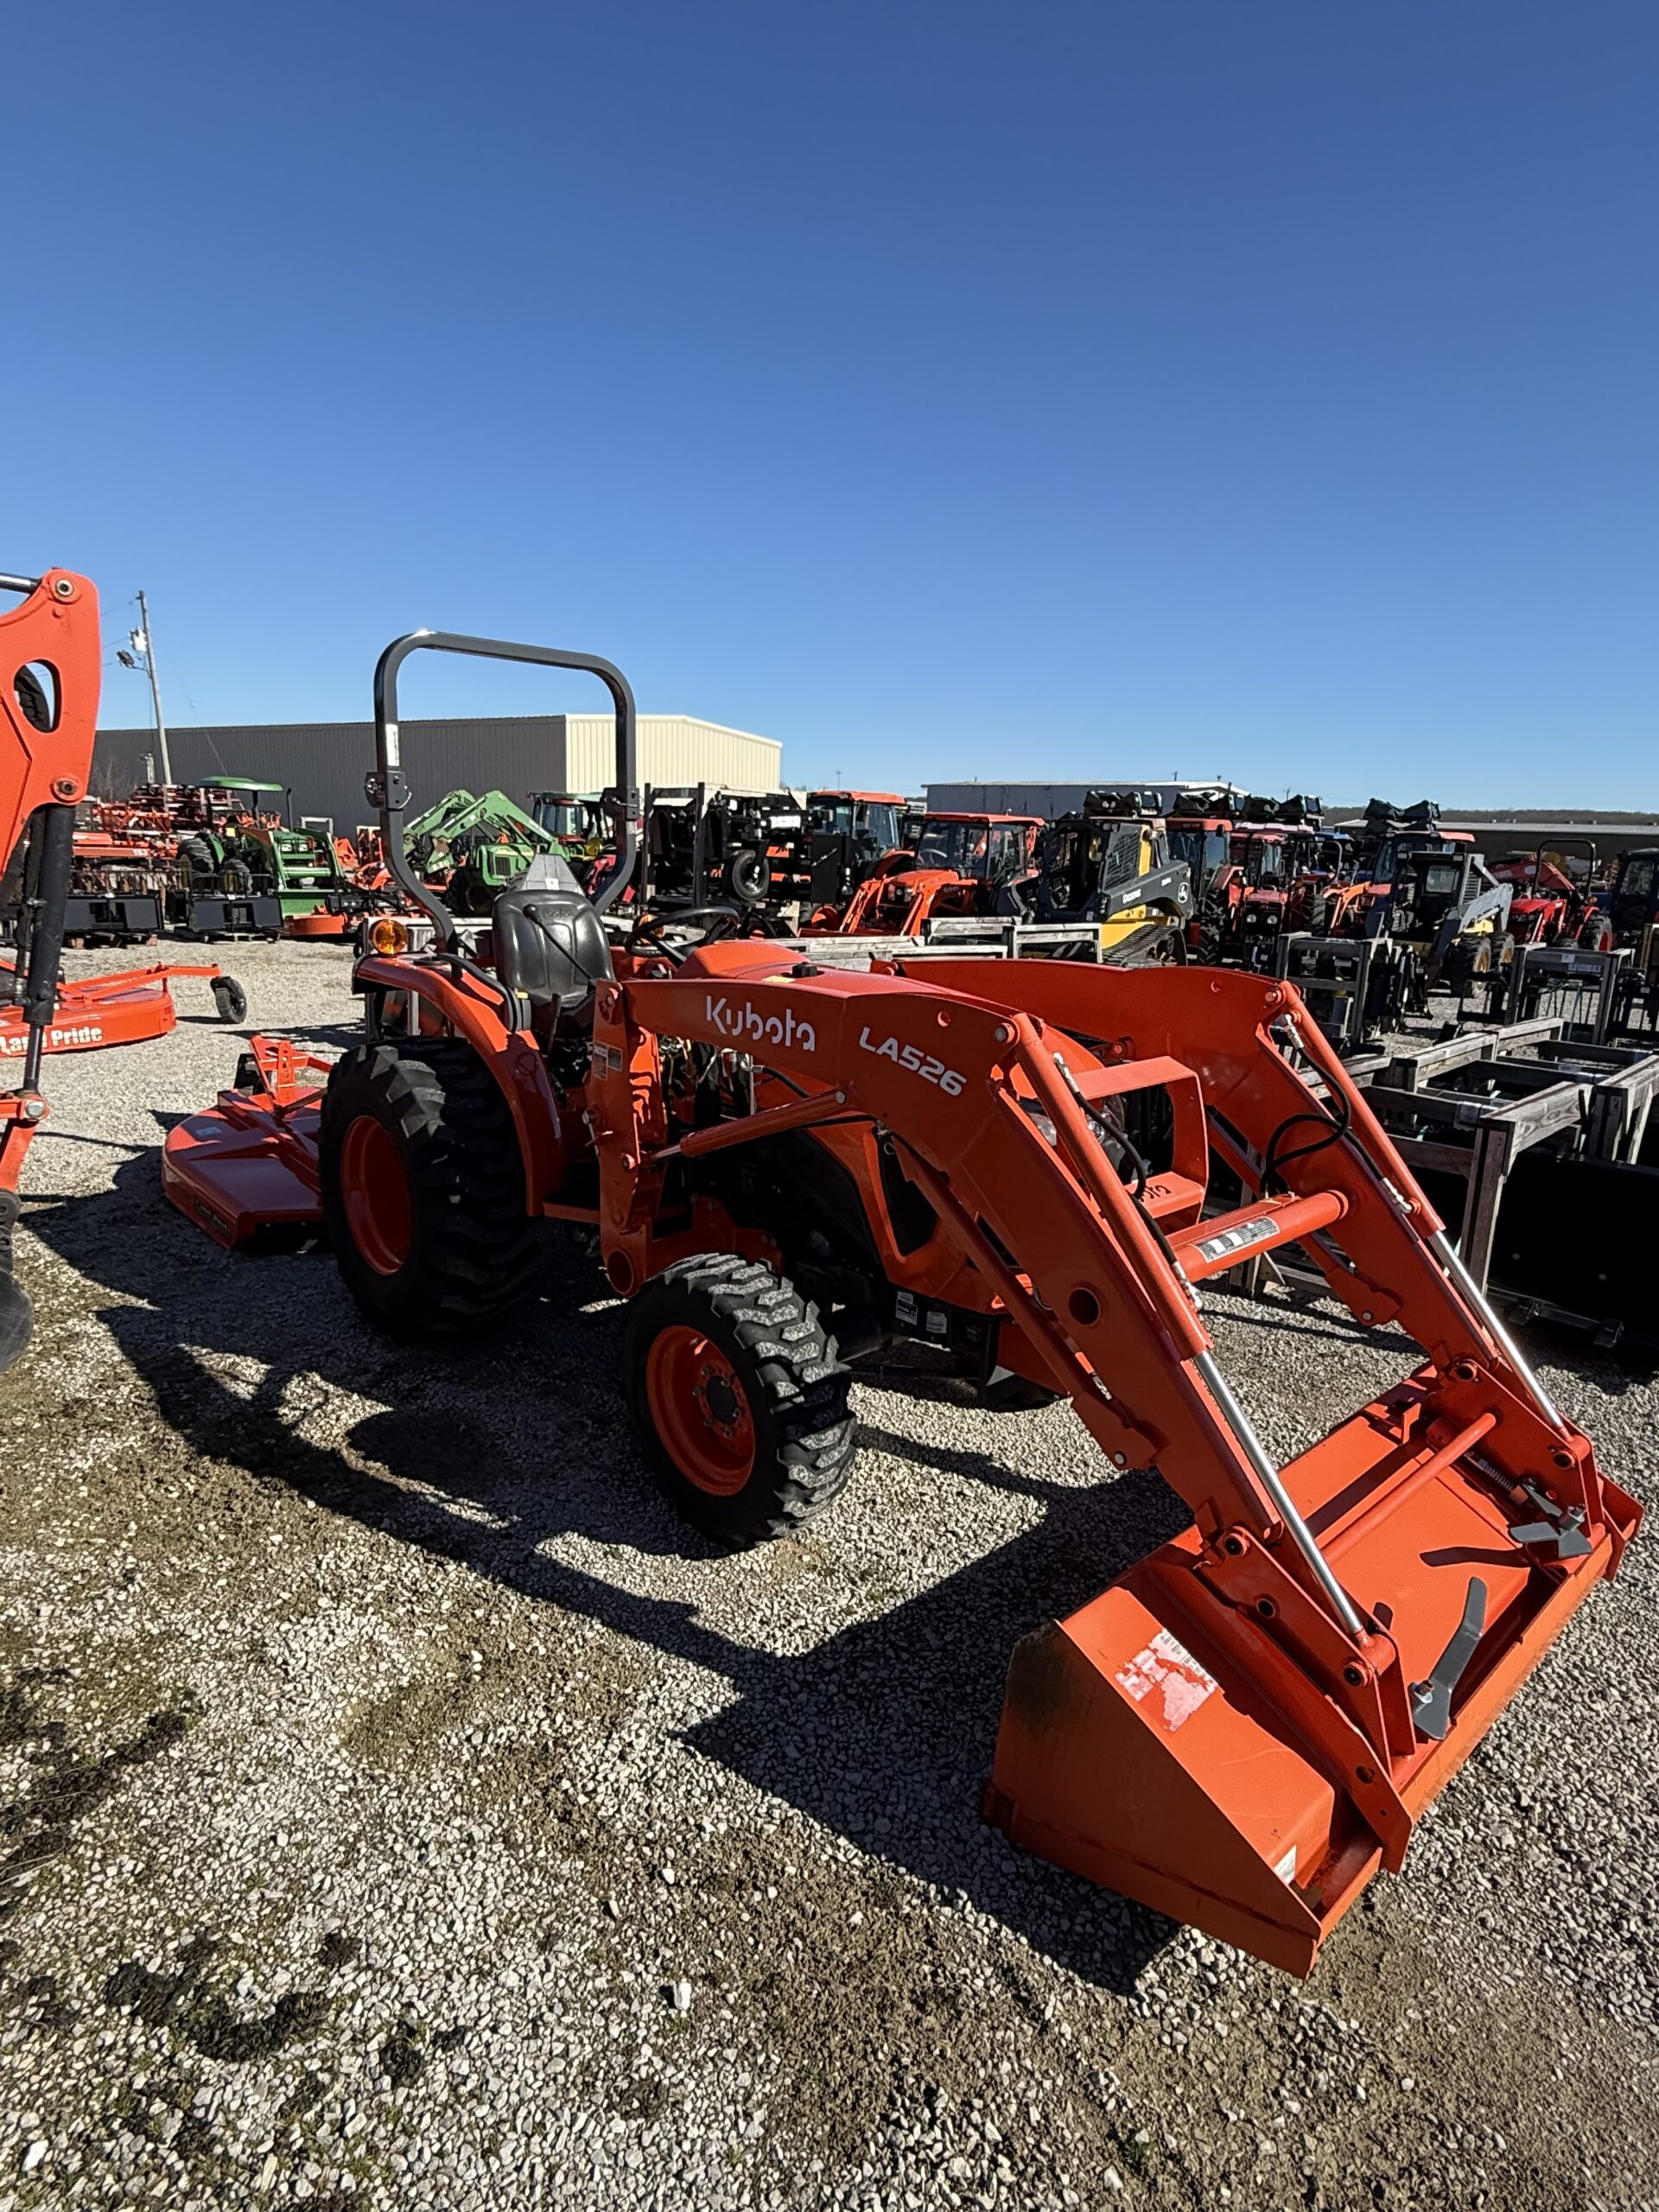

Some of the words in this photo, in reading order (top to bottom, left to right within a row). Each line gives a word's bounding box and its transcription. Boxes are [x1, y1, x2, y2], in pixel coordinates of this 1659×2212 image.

[50, 1026, 104, 1047] Pride
[705, 995, 816, 1052] Kubota
[859, 1027, 968, 1097] LA526
